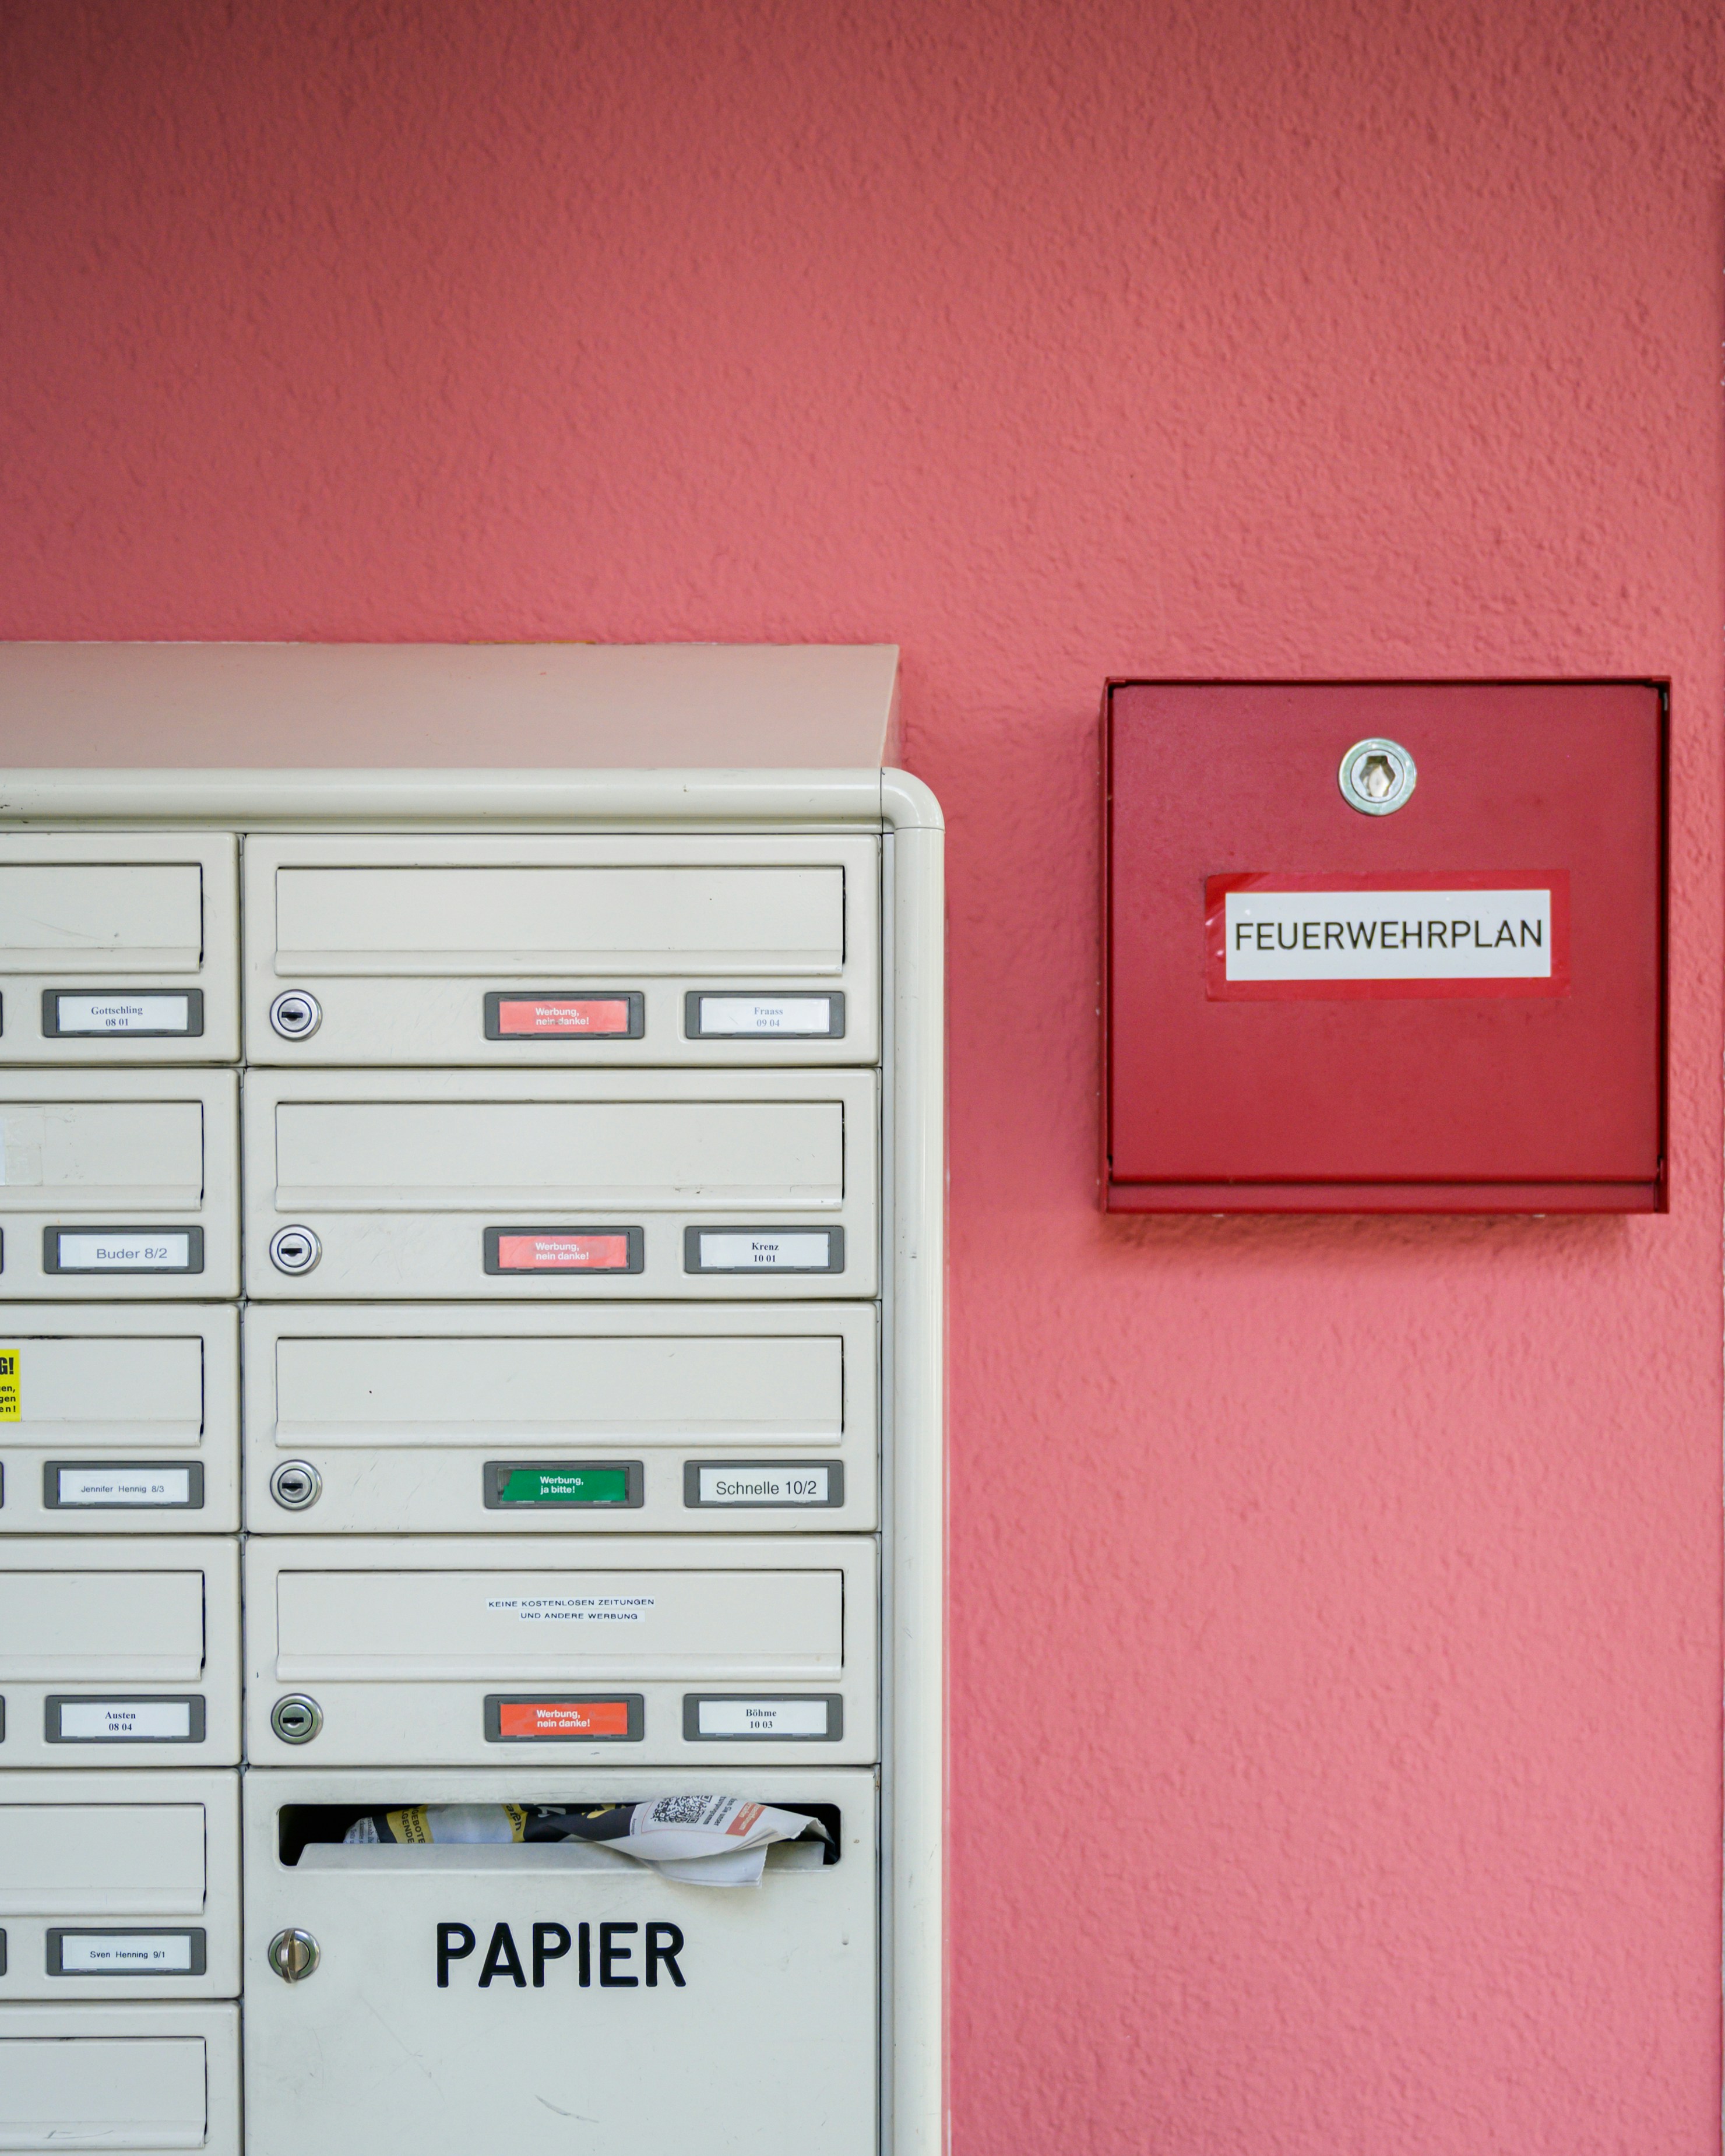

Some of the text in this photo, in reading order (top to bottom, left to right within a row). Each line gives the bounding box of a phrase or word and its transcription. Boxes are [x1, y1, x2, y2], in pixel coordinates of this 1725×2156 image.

[1235, 920, 1542, 951] FEUERWEHRPLAN
[91, 1005, 143, 1017] Gottschling
[536, 1008, 579, 1017] Werbung,
[754, 1007, 783, 1016] Fraass
[105, 1018, 129, 1027] 08 01
[756, 1019, 780, 1027] 09 04
[536, 1243, 579, 1252] Werbung,
[751, 1242, 779, 1250] Krenz
[96, 1248, 168, 1259] Buder 8/2
[754, 1255, 776, 1263] 10 01
[540, 1476, 584, 1485] Werbung,
[81, 1484, 165, 1494] Jennifer Hennig 8/3
[540, 1486, 549, 1494] ja
[716, 1481, 816, 1495] Schnelle 10/2
[105, 1711, 136, 1720] Austen
[536, 1710, 580, 1719] Werbung,
[745, 1708, 777, 1717] Böhme
[108, 1722, 133, 1731] 08 04
[749, 1721, 773, 1729] 10 03
[90, 1950, 166, 1959] Sven Henning 9/1
[436, 1922, 687, 1988] PAPIER
